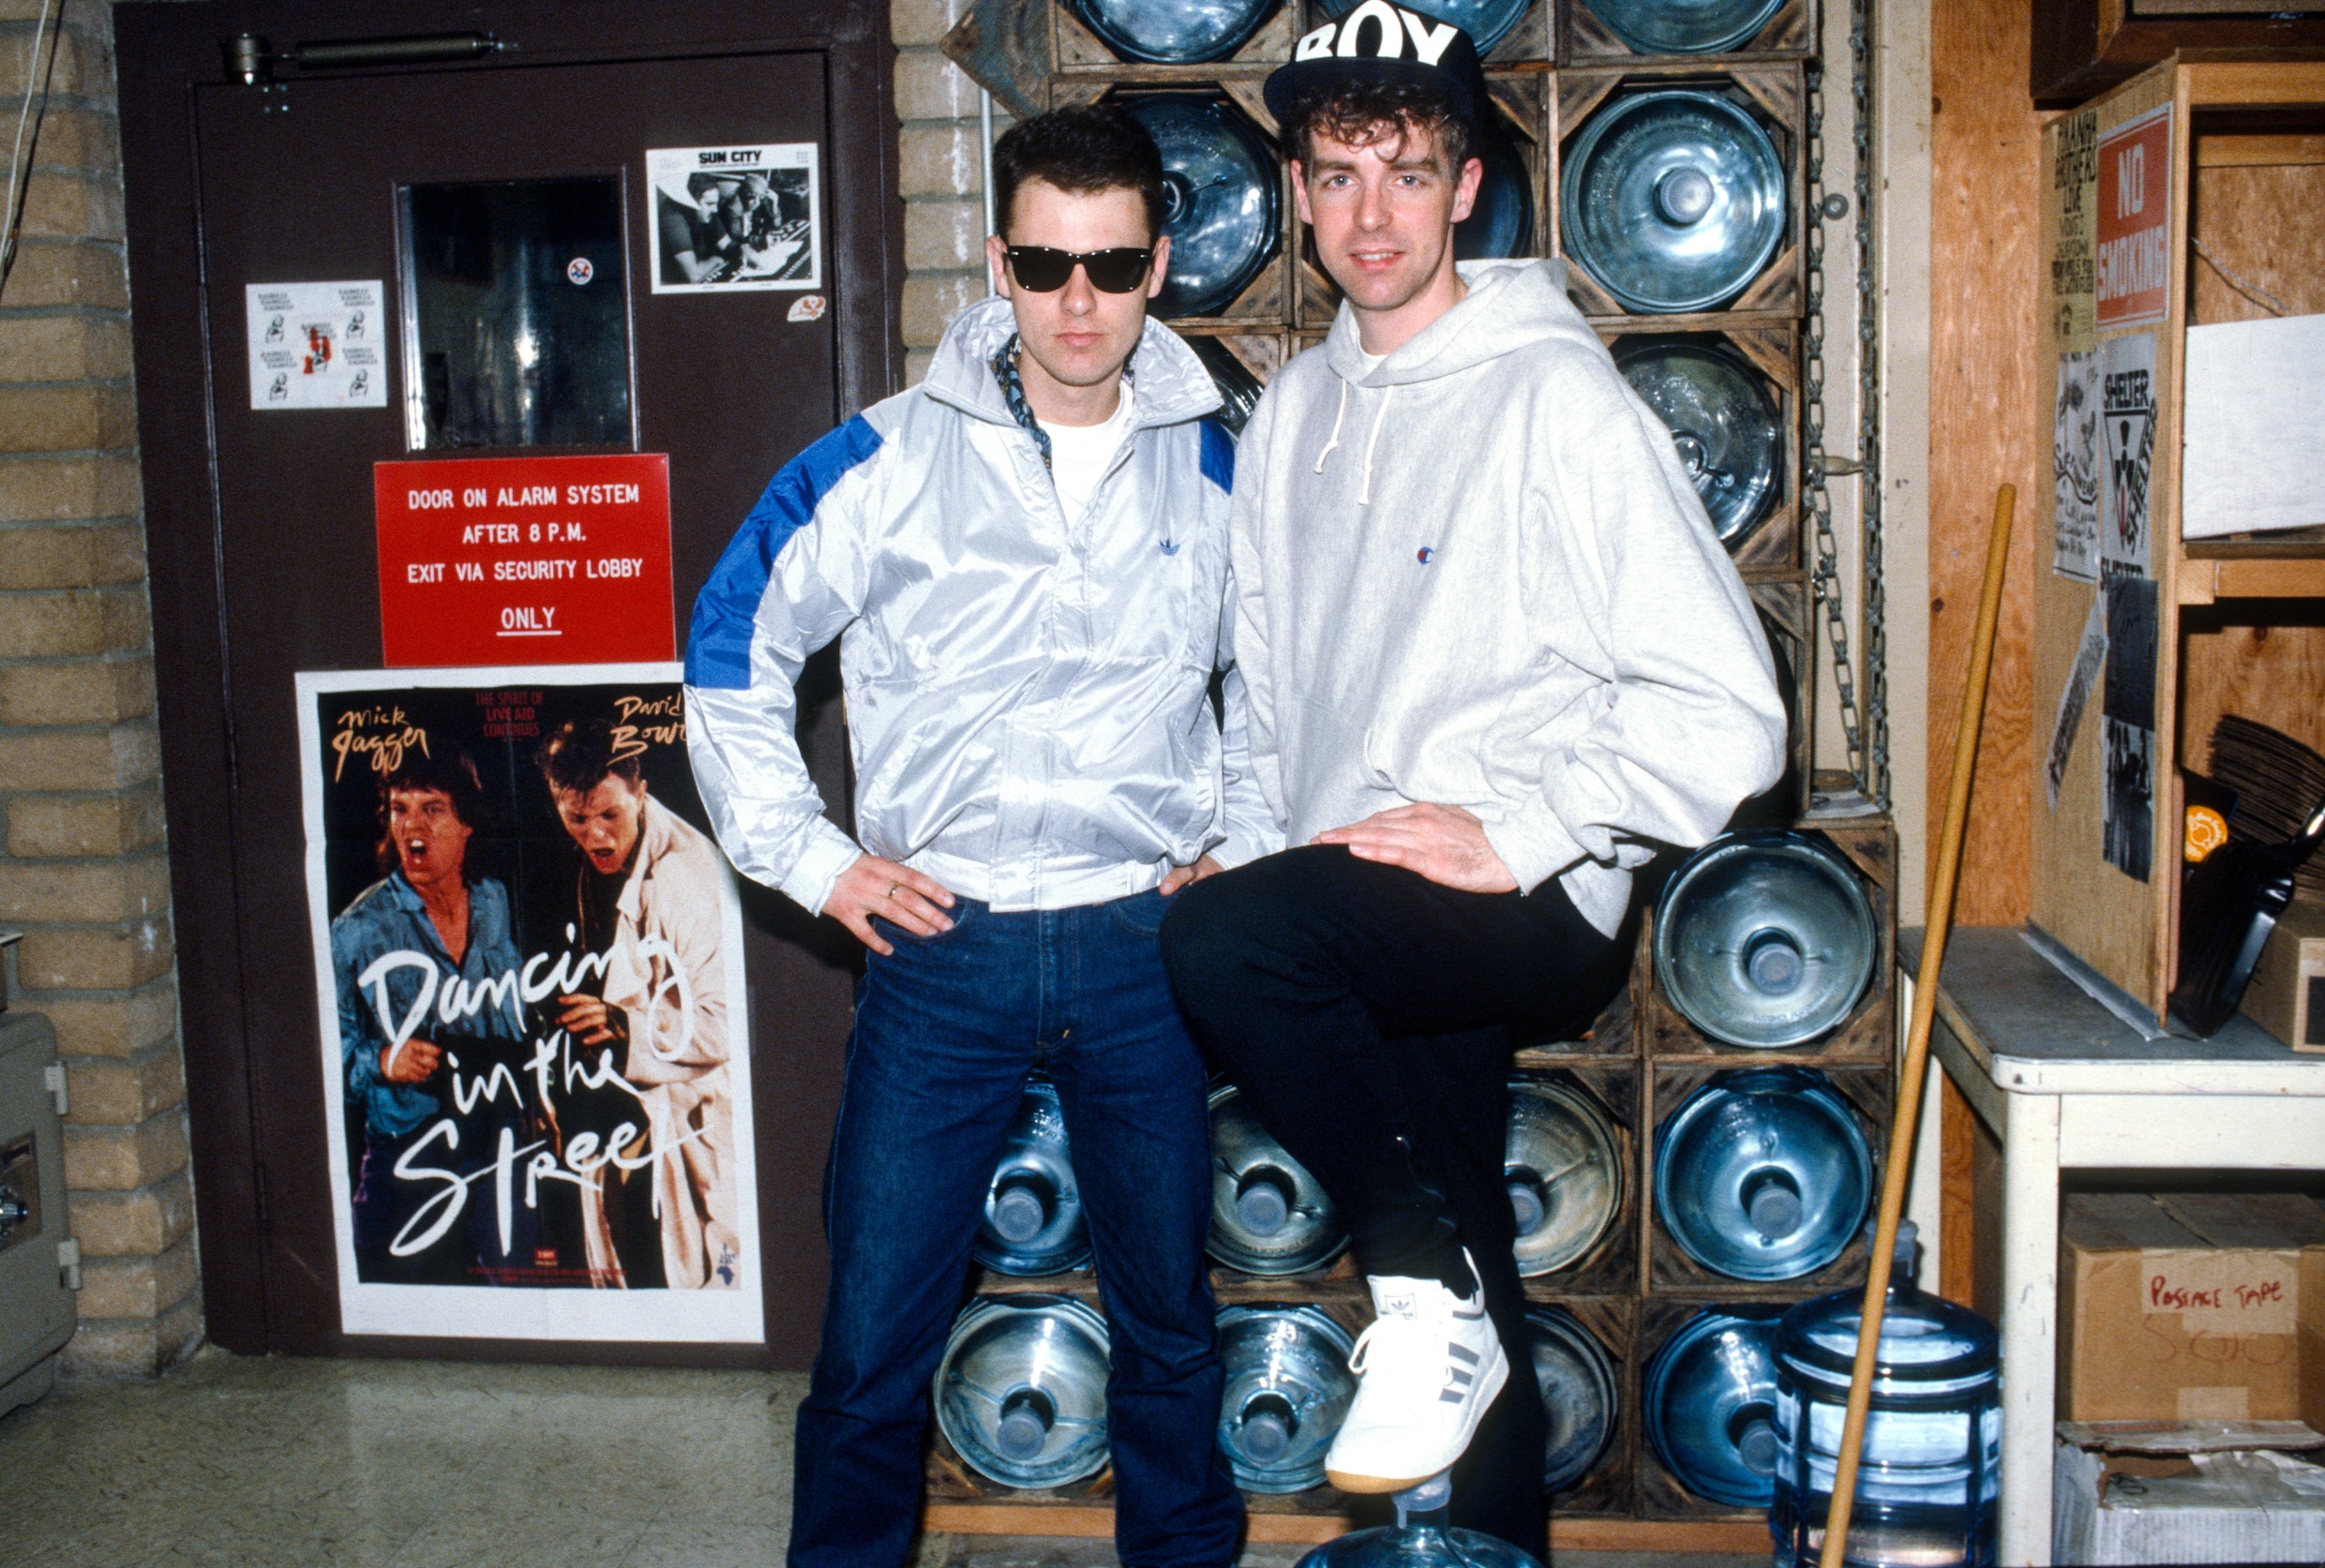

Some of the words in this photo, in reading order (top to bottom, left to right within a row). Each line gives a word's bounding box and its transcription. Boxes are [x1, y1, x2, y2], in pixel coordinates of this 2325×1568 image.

[1296, 0, 1459, 67] BOY
[698, 151, 727, 164] SUN
[731, 150, 762, 163] CITY
[2118, 142, 2144, 220] NO
[2097, 225, 2164, 302] SMOKING
[2104, 368, 2149, 410] SHELTER
[408, 489, 454, 510] DOOR
[463, 487, 488, 507] ON
[497, 485, 558, 506] ALARM
[567, 484, 639, 504] SYSTEM
[462, 524, 519, 545] AFTER
[529, 523, 541, 542] 8
[548, 522, 587, 542] P.M.
[407, 563, 445, 584] EXIT
[456, 562, 485, 581] VIA
[494, 560, 578, 581] SECURITY
[587, 558, 643, 578] LOBBY
[501, 606, 556, 630] ONLY
[475, 691, 493, 707] THE
[532, 690, 543, 706] OF
[614, 691, 683, 724] David
[486, 706, 511, 722] LIVE
[515, 706, 535, 721] AID
[357, 922, 694, 1077] Dancing
[447, 1050, 524, 1114] in
[523, 1028, 647, 1115] the
[2234, 1280, 2284, 1309] TAPE
